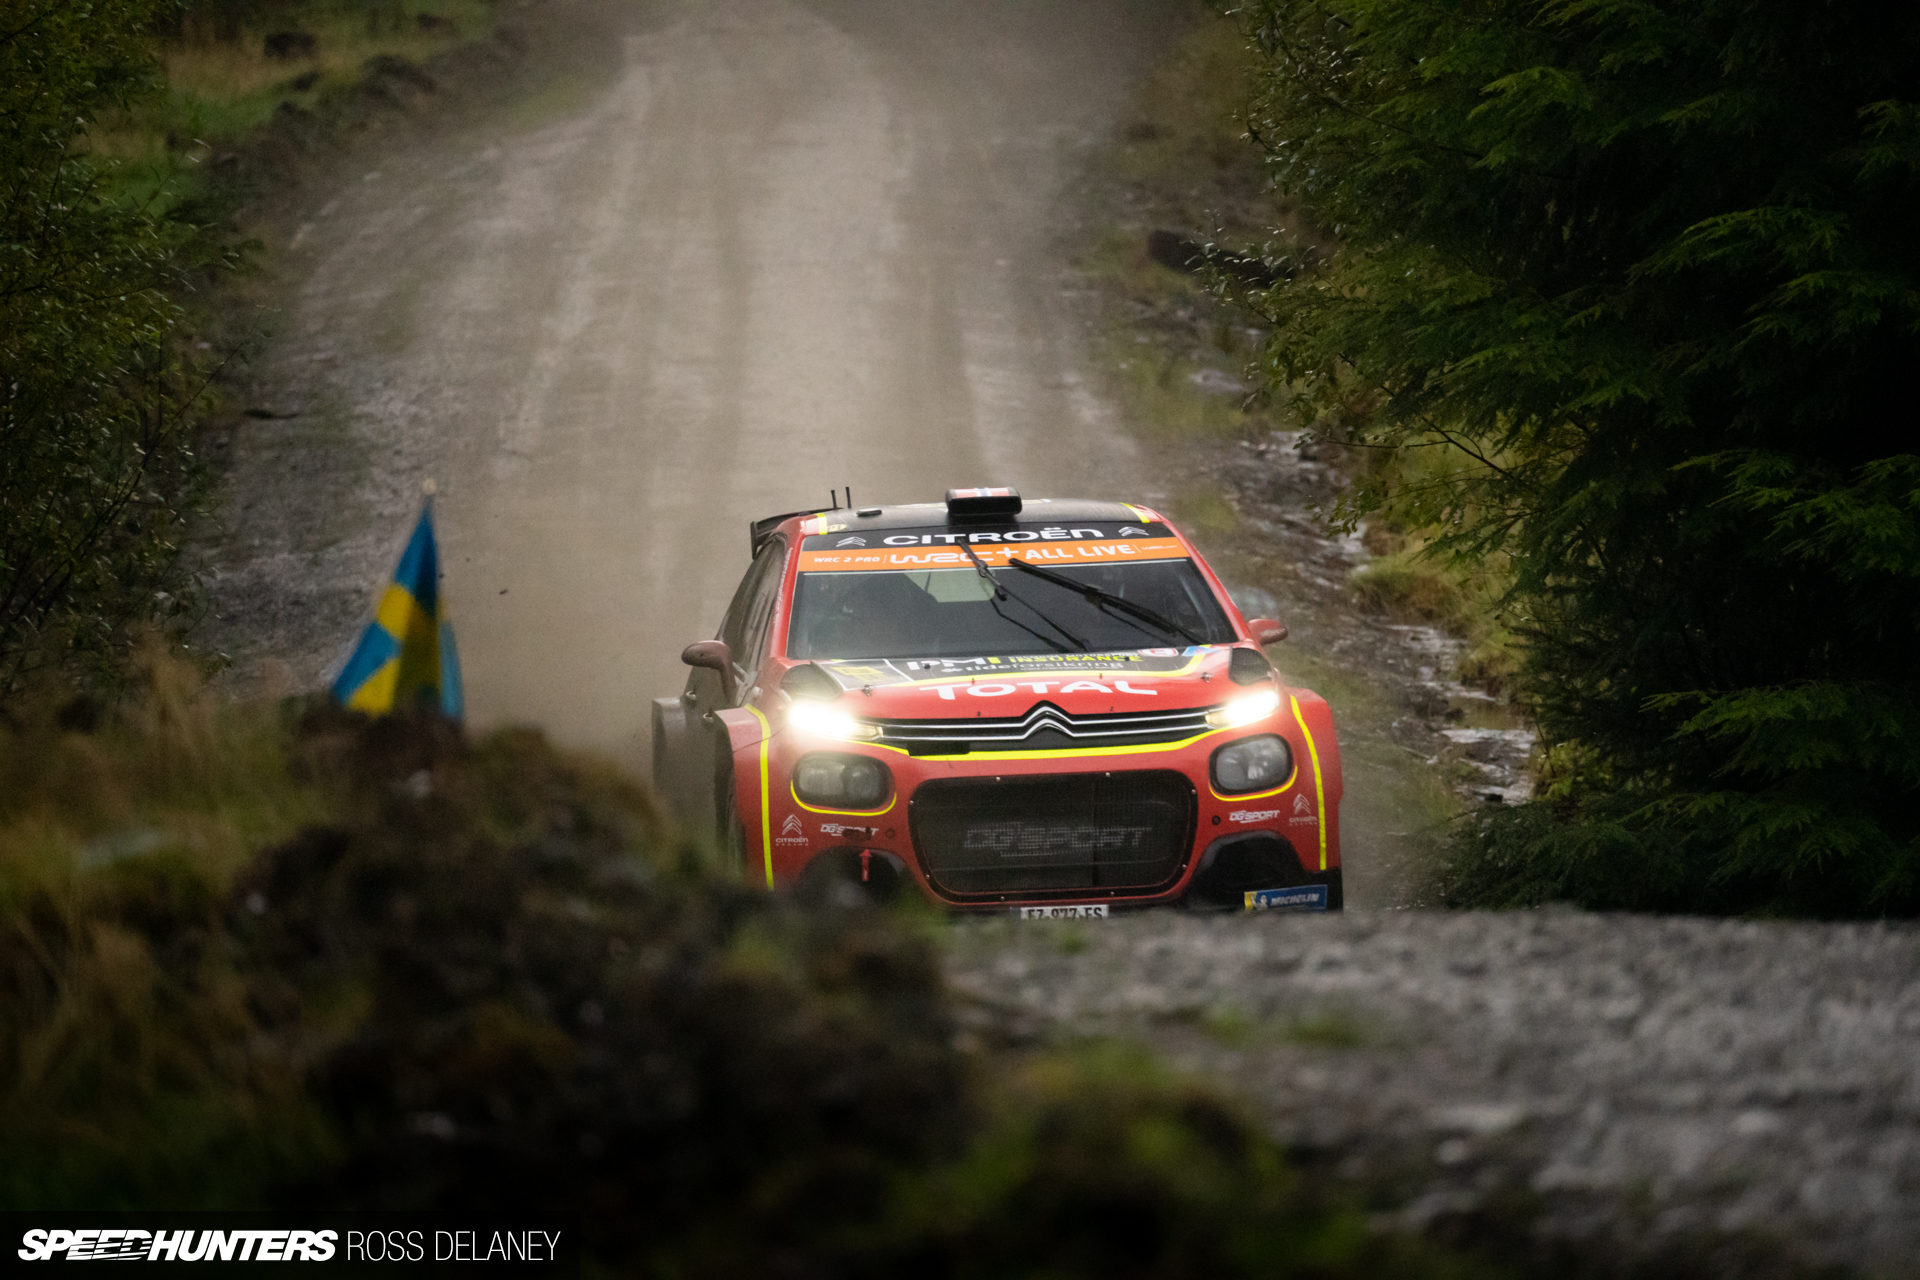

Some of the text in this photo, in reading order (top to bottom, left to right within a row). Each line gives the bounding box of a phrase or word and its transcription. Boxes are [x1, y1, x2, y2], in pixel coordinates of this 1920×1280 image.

[1025, 548, 1074, 560] ALL
[1077, 544, 1136, 557] LIVE
[1009, 655, 1143, 664] INSURANCE
[919, 680, 1158, 700] TOTAL
